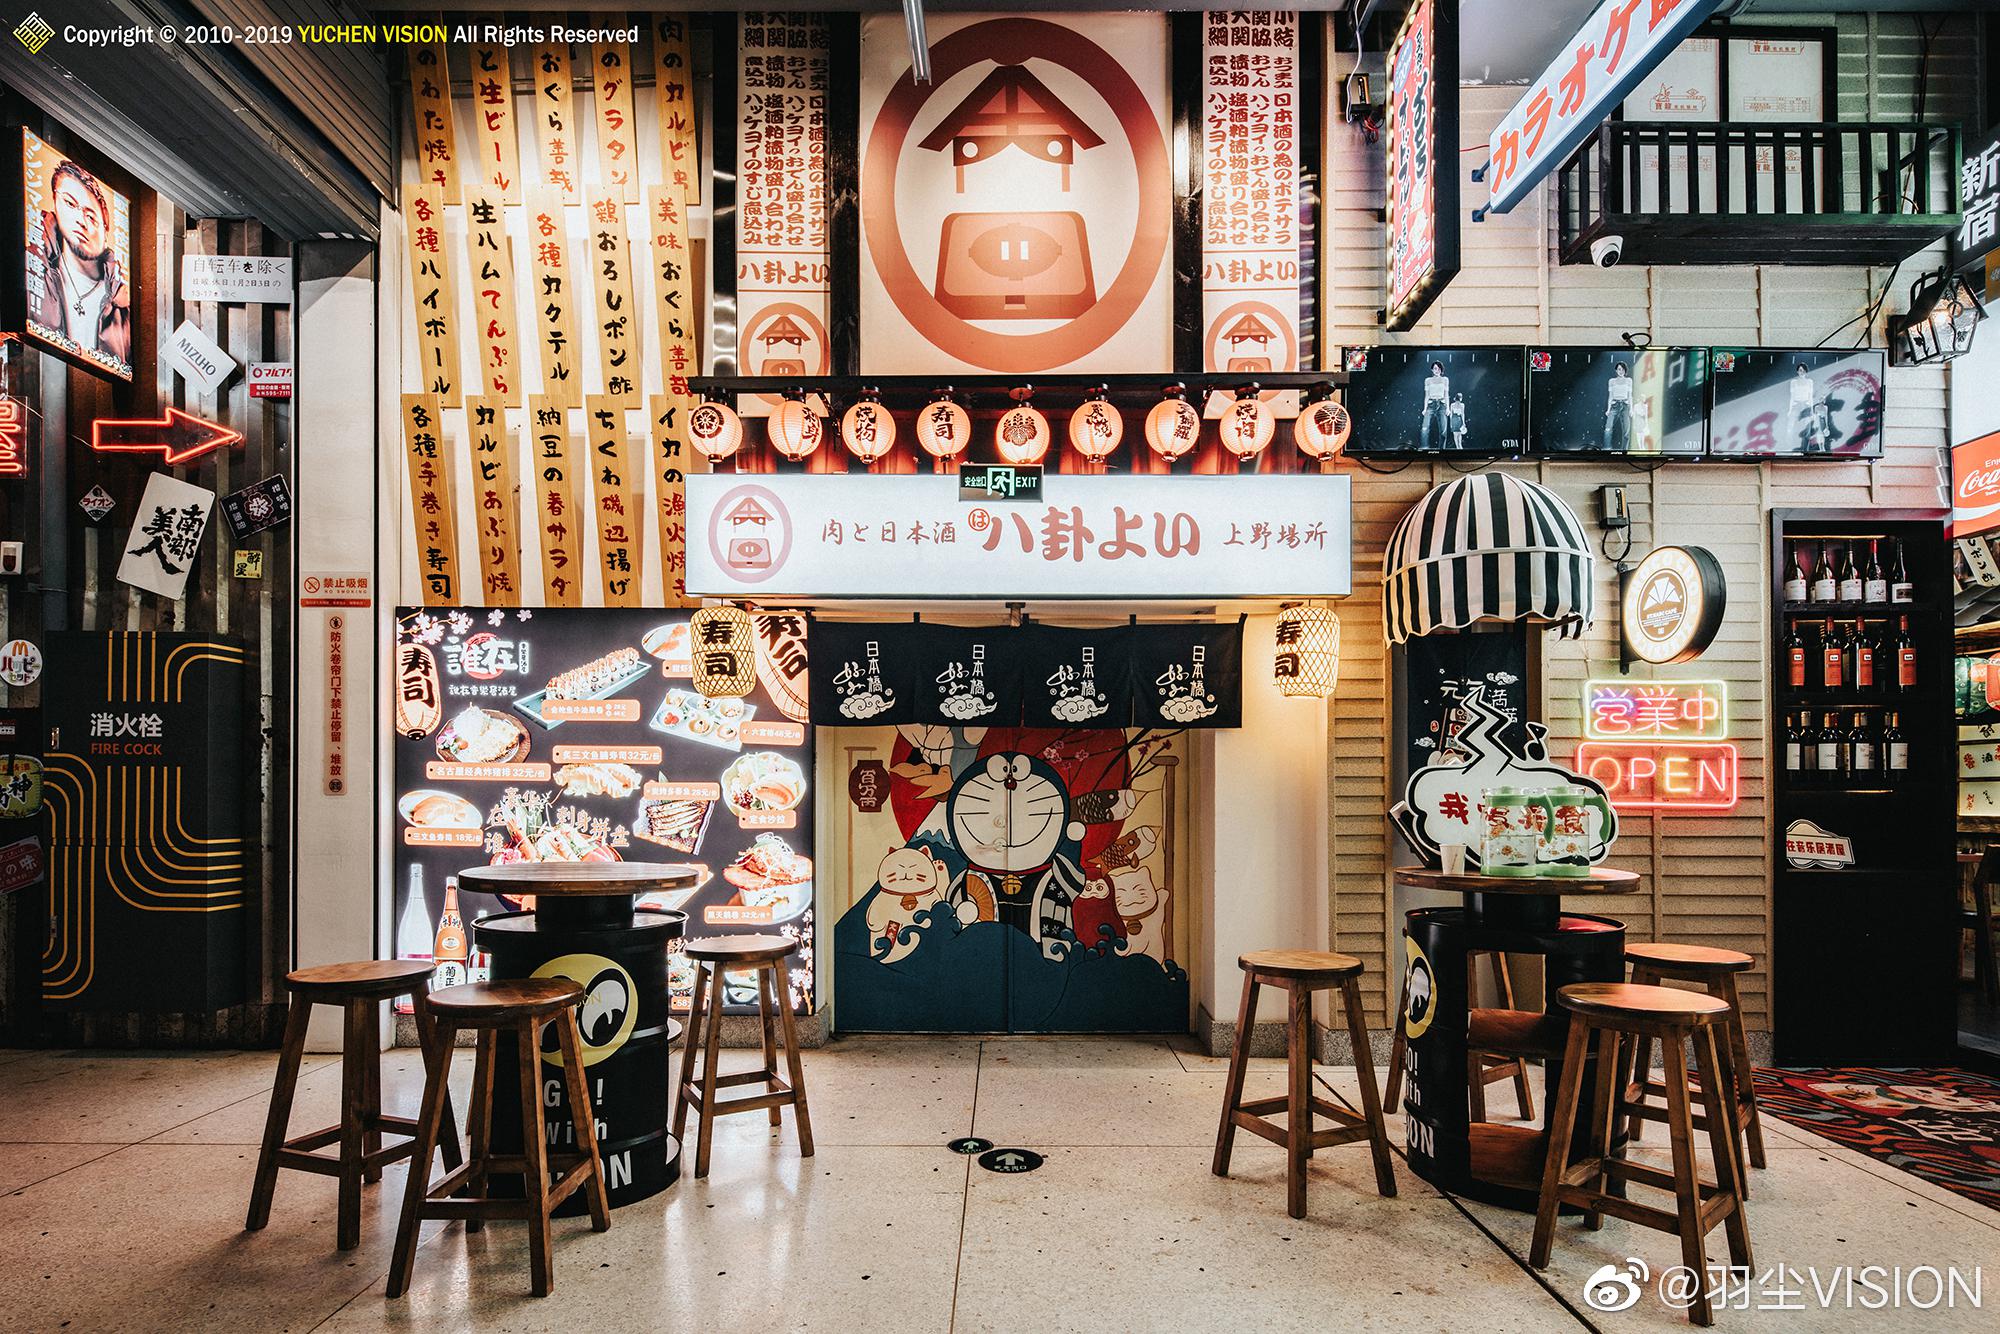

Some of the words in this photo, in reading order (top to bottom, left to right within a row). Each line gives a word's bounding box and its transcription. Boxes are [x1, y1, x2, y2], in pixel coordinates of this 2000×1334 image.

[1251, 55, 1271, 88] おでん
[1957, 140, 2000, 251] 新宿
[414, 198, 451, 395] 各種ハイボール
[472, 198, 509, 395] 生ハムてんぷら
[536, 212, 570, 381] 各種カクテル
[592, 197, 634, 395] 鶏おろしポン酢
[657, 197, 693, 397] 美味おぐら善哉
[738, 260, 831, 285] 八卦よい
[1203, 259, 1298, 283] 八卦よい
[177, 338, 216, 376] MIZUHO
[931, 406, 954, 441] 寿司
[411, 404, 452, 600] 各種手巻き寿司
[475, 405, 513, 594] カルビあぶり焼
[536, 406, 572, 597] 納豆の春サラダ
[594, 408, 631, 597] ちくわ磯辺揚げ
[964, 476, 987, 487] 安全出口
[1015, 477, 1038, 488] EXIT
[127, 506, 185, 575] 美人
[821, 519, 957, 546] 肉と日本酒
[983, 506, 1201, 563] 八卦よい
[1222, 521, 1328, 550] 上野場所
[323, 578, 368, 588] 禁止吸烟
[701, 620, 738, 677] 寿司
[866, 641, 883, 693] 日本橋
[969, 644, 985, 696] 日本橋
[1082, 646, 1096, 697] 日本橋
[1190, 645, 1206, 697] 日本橋
[1274, 620, 1301, 678] 寿司
[330, 631, 342, 776] 防火卷帘门下禁止停留、堆放
[401, 647, 436, 709] 寿司
[90, 712, 164, 739] 消火栓
[1590, 686, 1719, 735] 営業中
[90, 743, 120, 756] FIRE
[124, 743, 163, 756] COCK
[1588, 756, 1727, 793] OPEN
